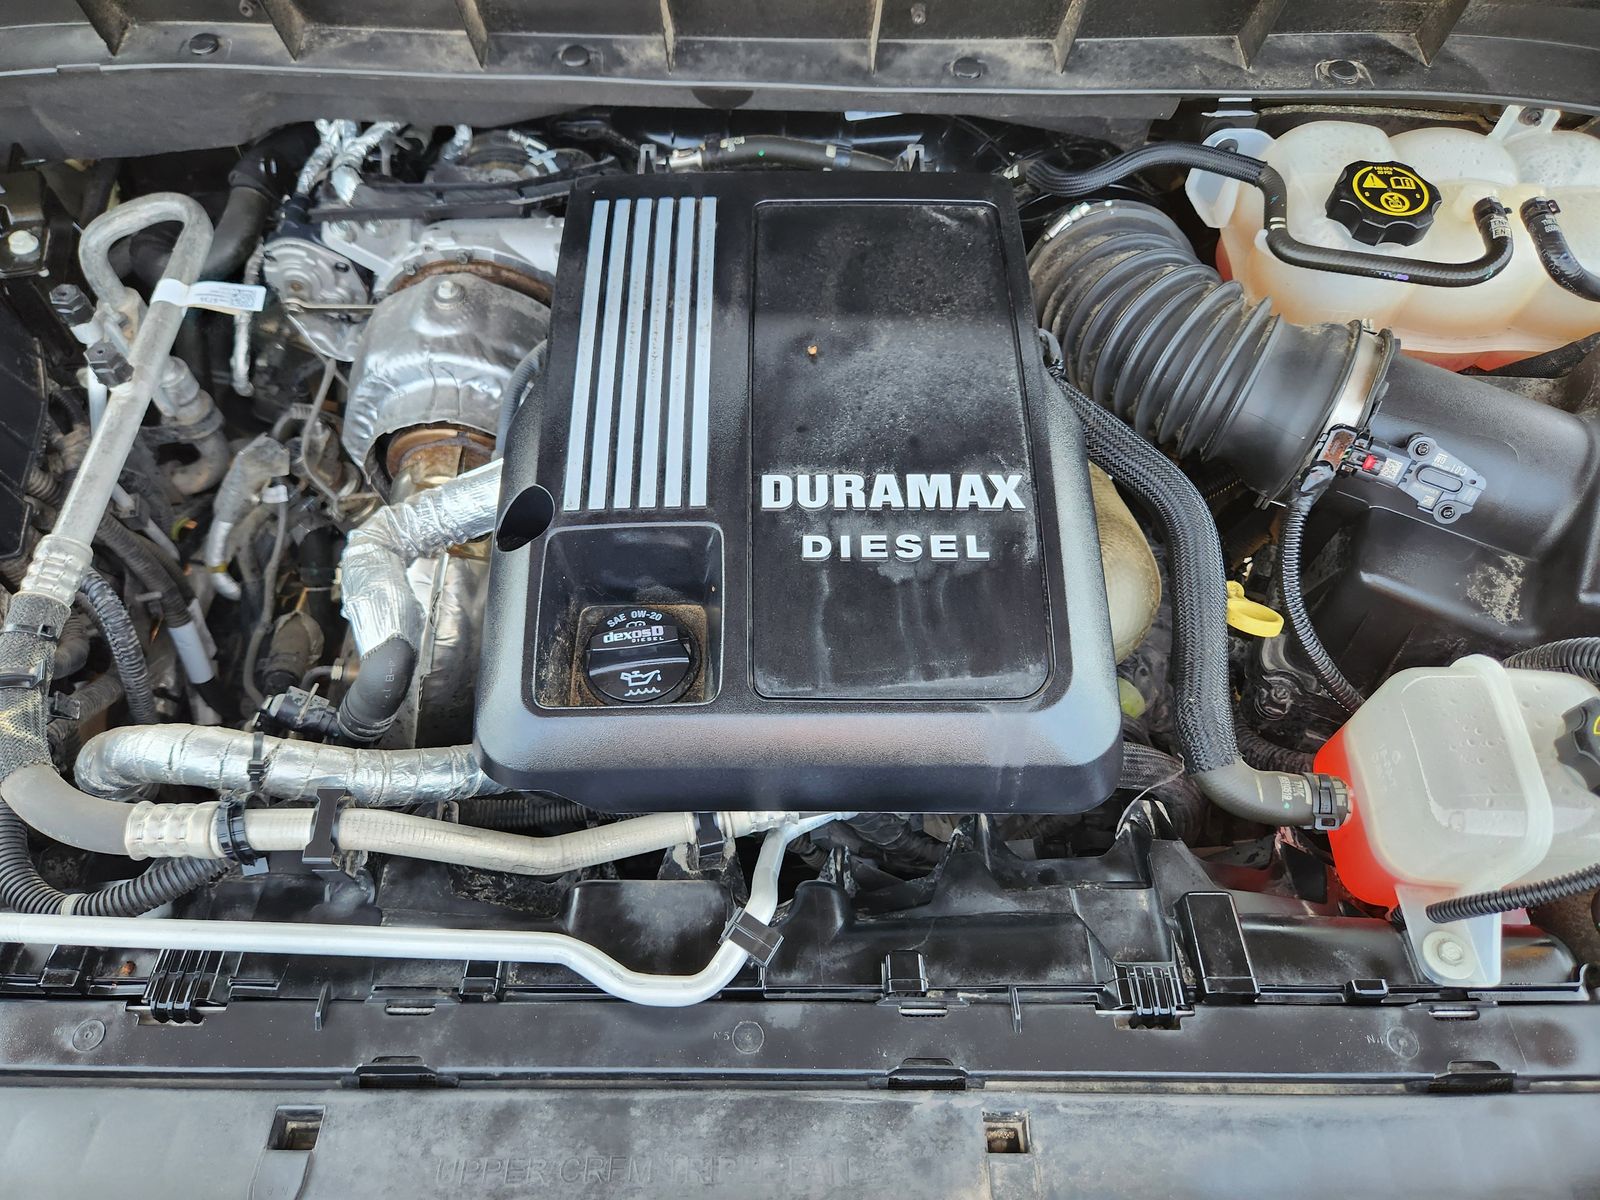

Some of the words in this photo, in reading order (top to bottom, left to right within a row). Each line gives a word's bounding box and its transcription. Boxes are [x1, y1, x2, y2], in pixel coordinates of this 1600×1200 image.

[761, 474, 1027, 511] DURAMAX
[801, 534, 990, 562] DIESEL
[607, 613, 627, 628] SAE
[631, 610, 663, 621] 0W-20
[436, 1156, 549, 1186] UPPER
